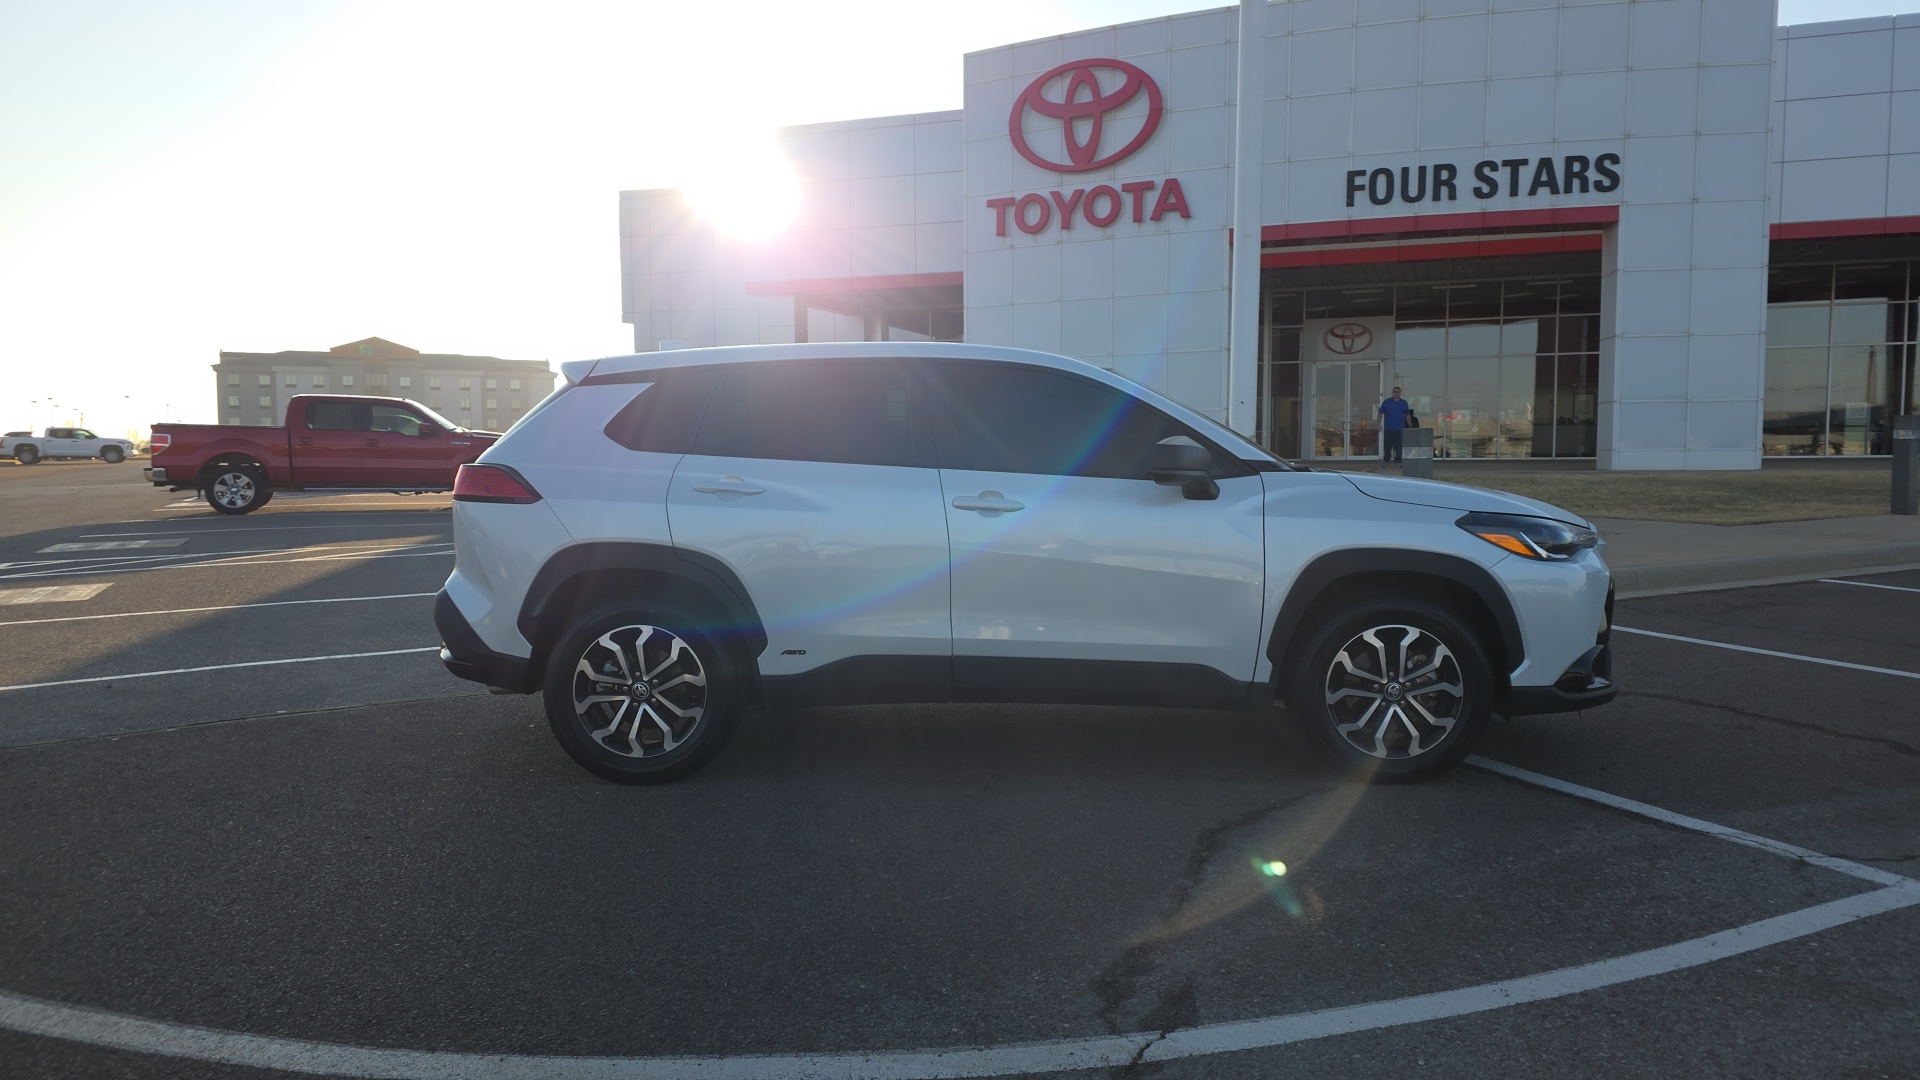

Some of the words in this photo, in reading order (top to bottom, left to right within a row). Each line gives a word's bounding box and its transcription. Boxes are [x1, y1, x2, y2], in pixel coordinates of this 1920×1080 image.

[986, 178, 1192, 238] TOYOTA
[1346, 162, 1458, 208] FOUR
[1472, 152, 1621, 200] STARS
